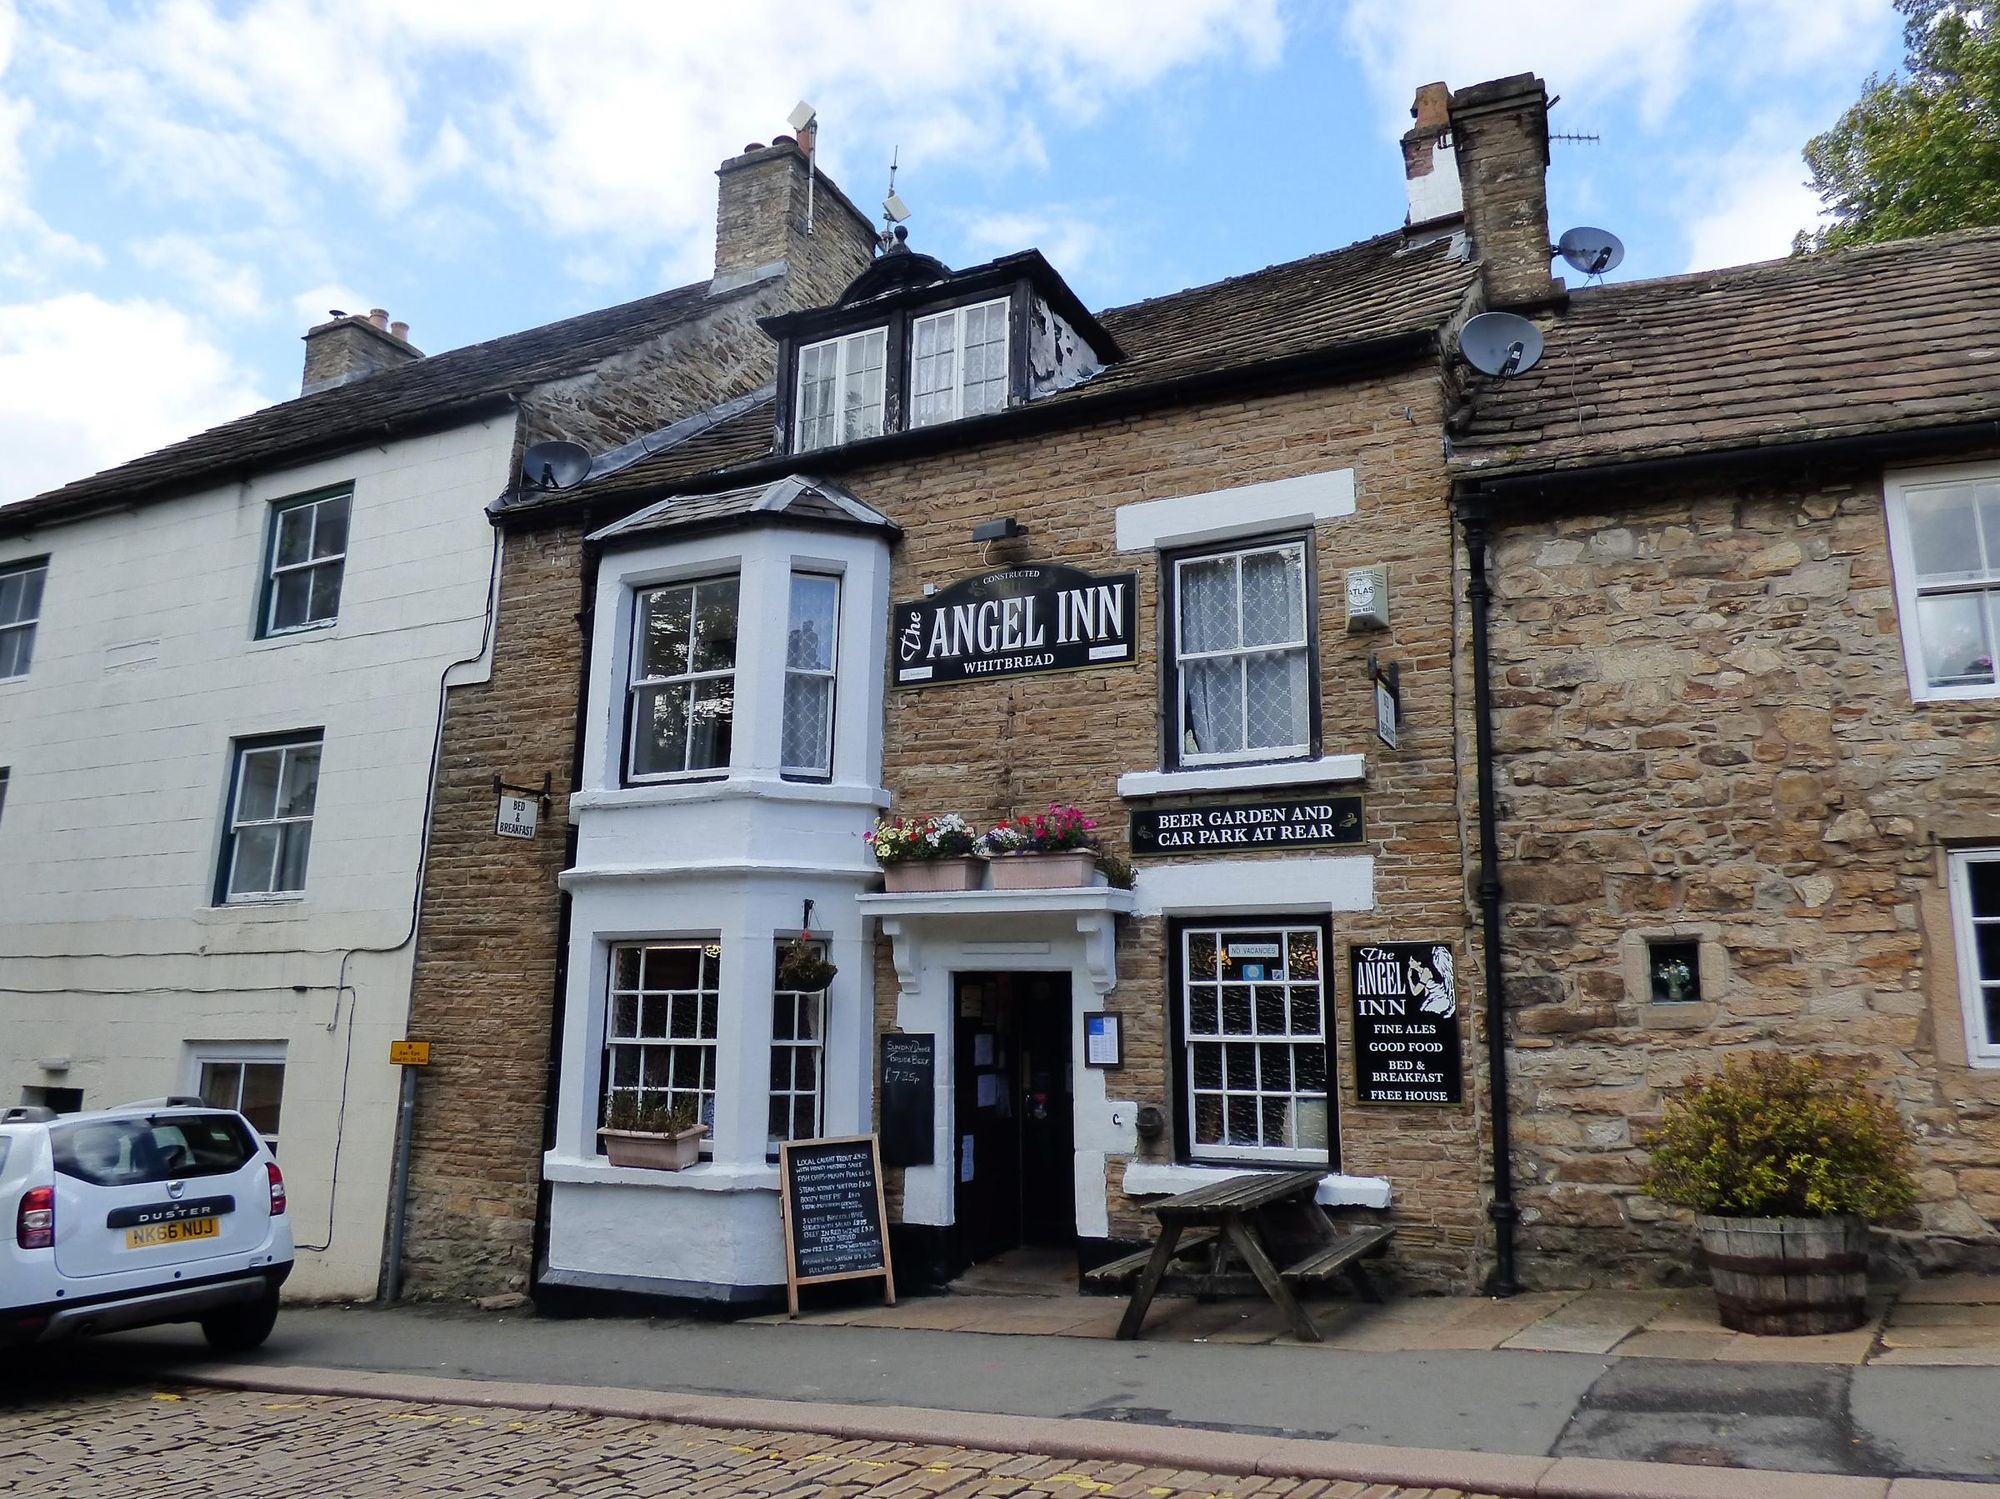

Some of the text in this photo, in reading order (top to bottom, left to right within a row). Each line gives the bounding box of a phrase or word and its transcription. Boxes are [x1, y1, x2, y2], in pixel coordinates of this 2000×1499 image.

[983, 570, 1040, 585] CONSTRUCTED
[926, 583, 1125, 659] ANGEL INN
[900, 610, 922, 662] The
[963, 653, 1055, 674] WHITBREAD
[513, 800, 525, 811] BED
[515, 812, 520, 822] &
[1158, 805, 1333, 829] BEER GARDEN AND
[500, 822, 533, 836] BREAKFAST
[1158, 823, 1335, 846] CAR PARK AT REAR
[1231, 947, 1276, 955] NO VACANCIES
[1360, 947, 1395, 961] The
[1357, 961, 1406, 996] ANGEL
[1359, 999, 1406, 1016] INN
[1374, 1024, 1436, 1034] FINE ALES
[1369, 1042, 1443, 1053] GOOD FOOD
[1388, 1060, 1426, 1070] BED &
[1372, 1072, 1444, 1083] BREAKFAST
[1370, 1090, 1448, 1101] FREE HOUSE
[796, 1159, 816, 1167] LOCAL
[139, 1206, 212, 1222] DUSTER
[133, 1219, 213, 1245] NK66 NUJ
